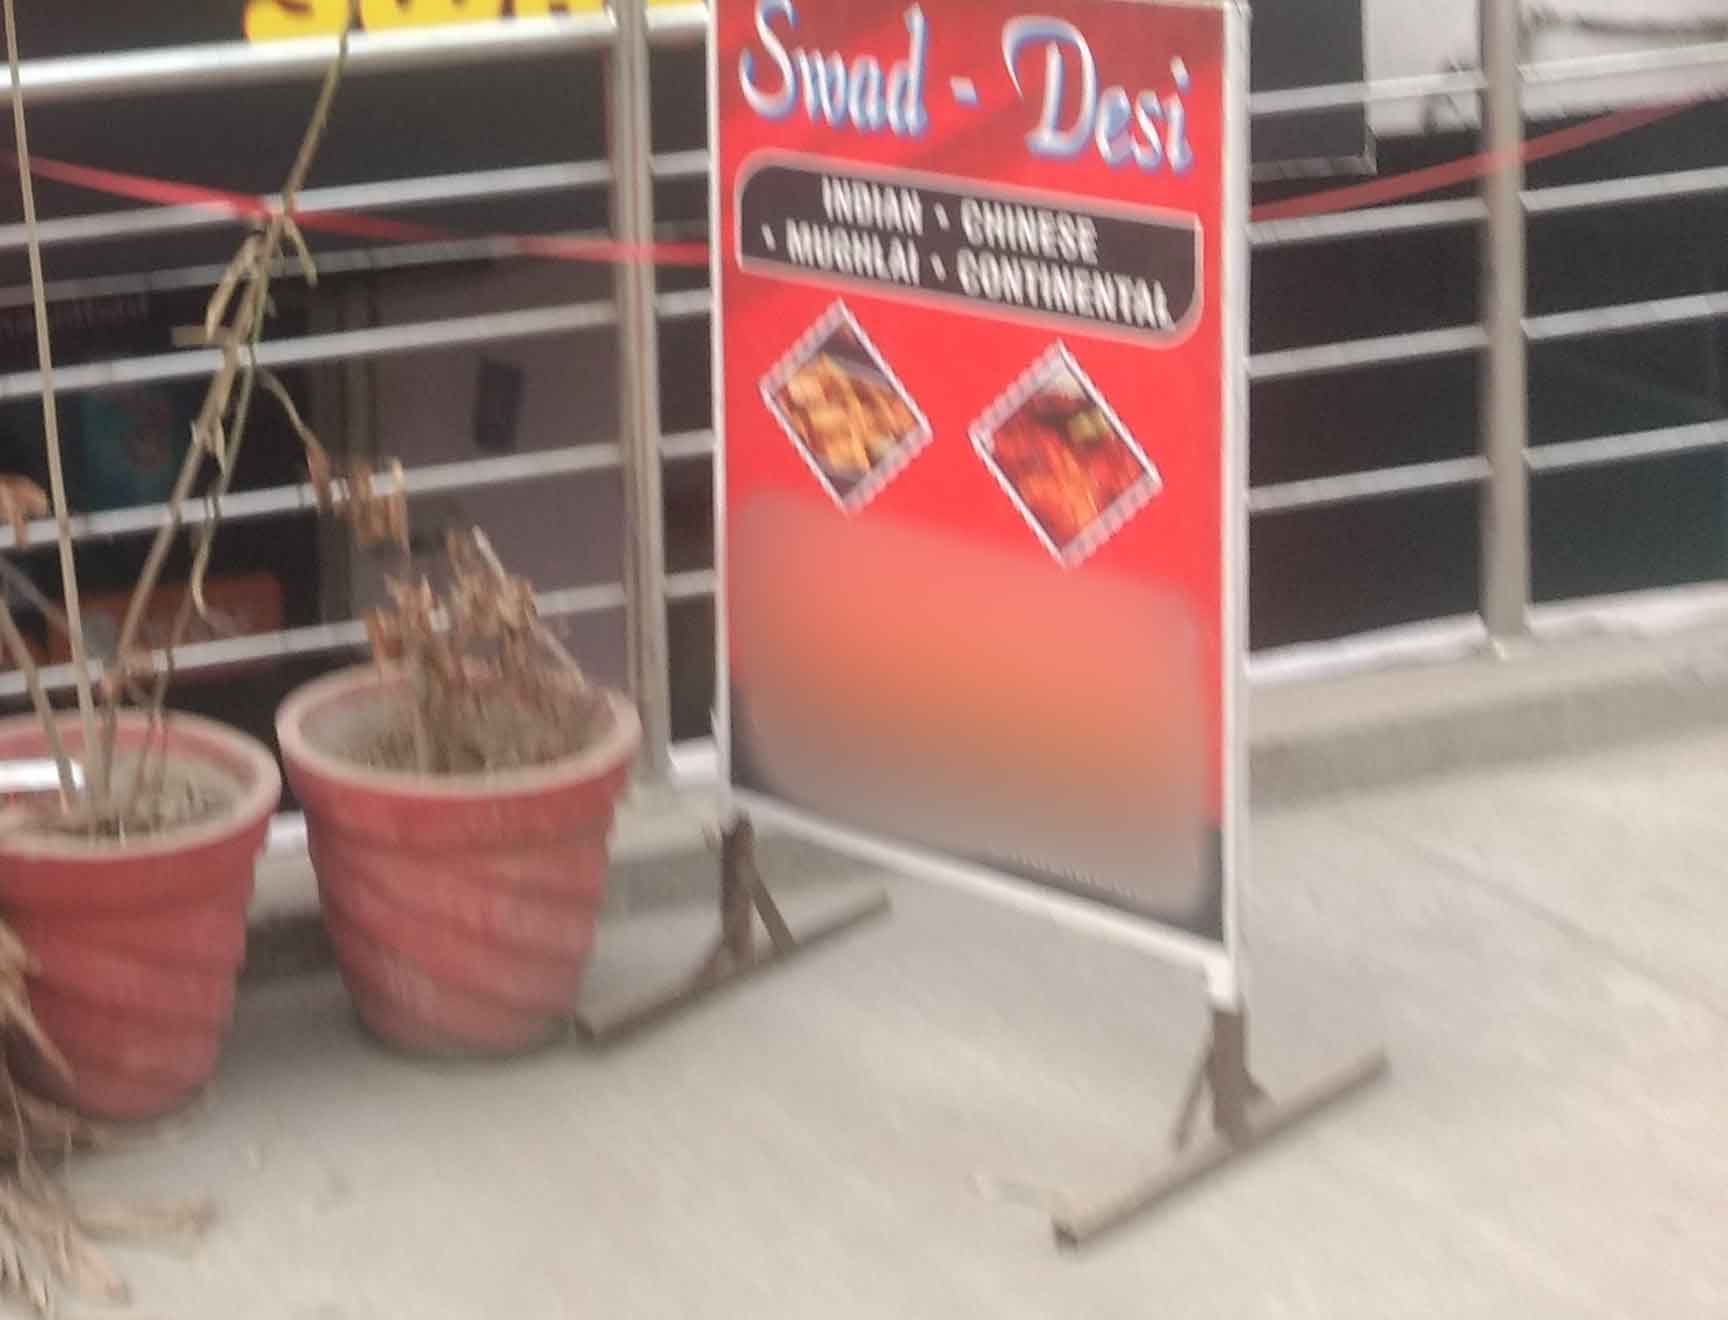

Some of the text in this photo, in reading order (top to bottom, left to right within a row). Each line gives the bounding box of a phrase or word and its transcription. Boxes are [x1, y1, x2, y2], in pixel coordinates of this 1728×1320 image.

[1000, 15, 1195, 176] Desi
[784, 216, 1178, 333] MUGHLAI CONTINENTAL
[820, 174, 1100, 265] INDIAN CHINESE
